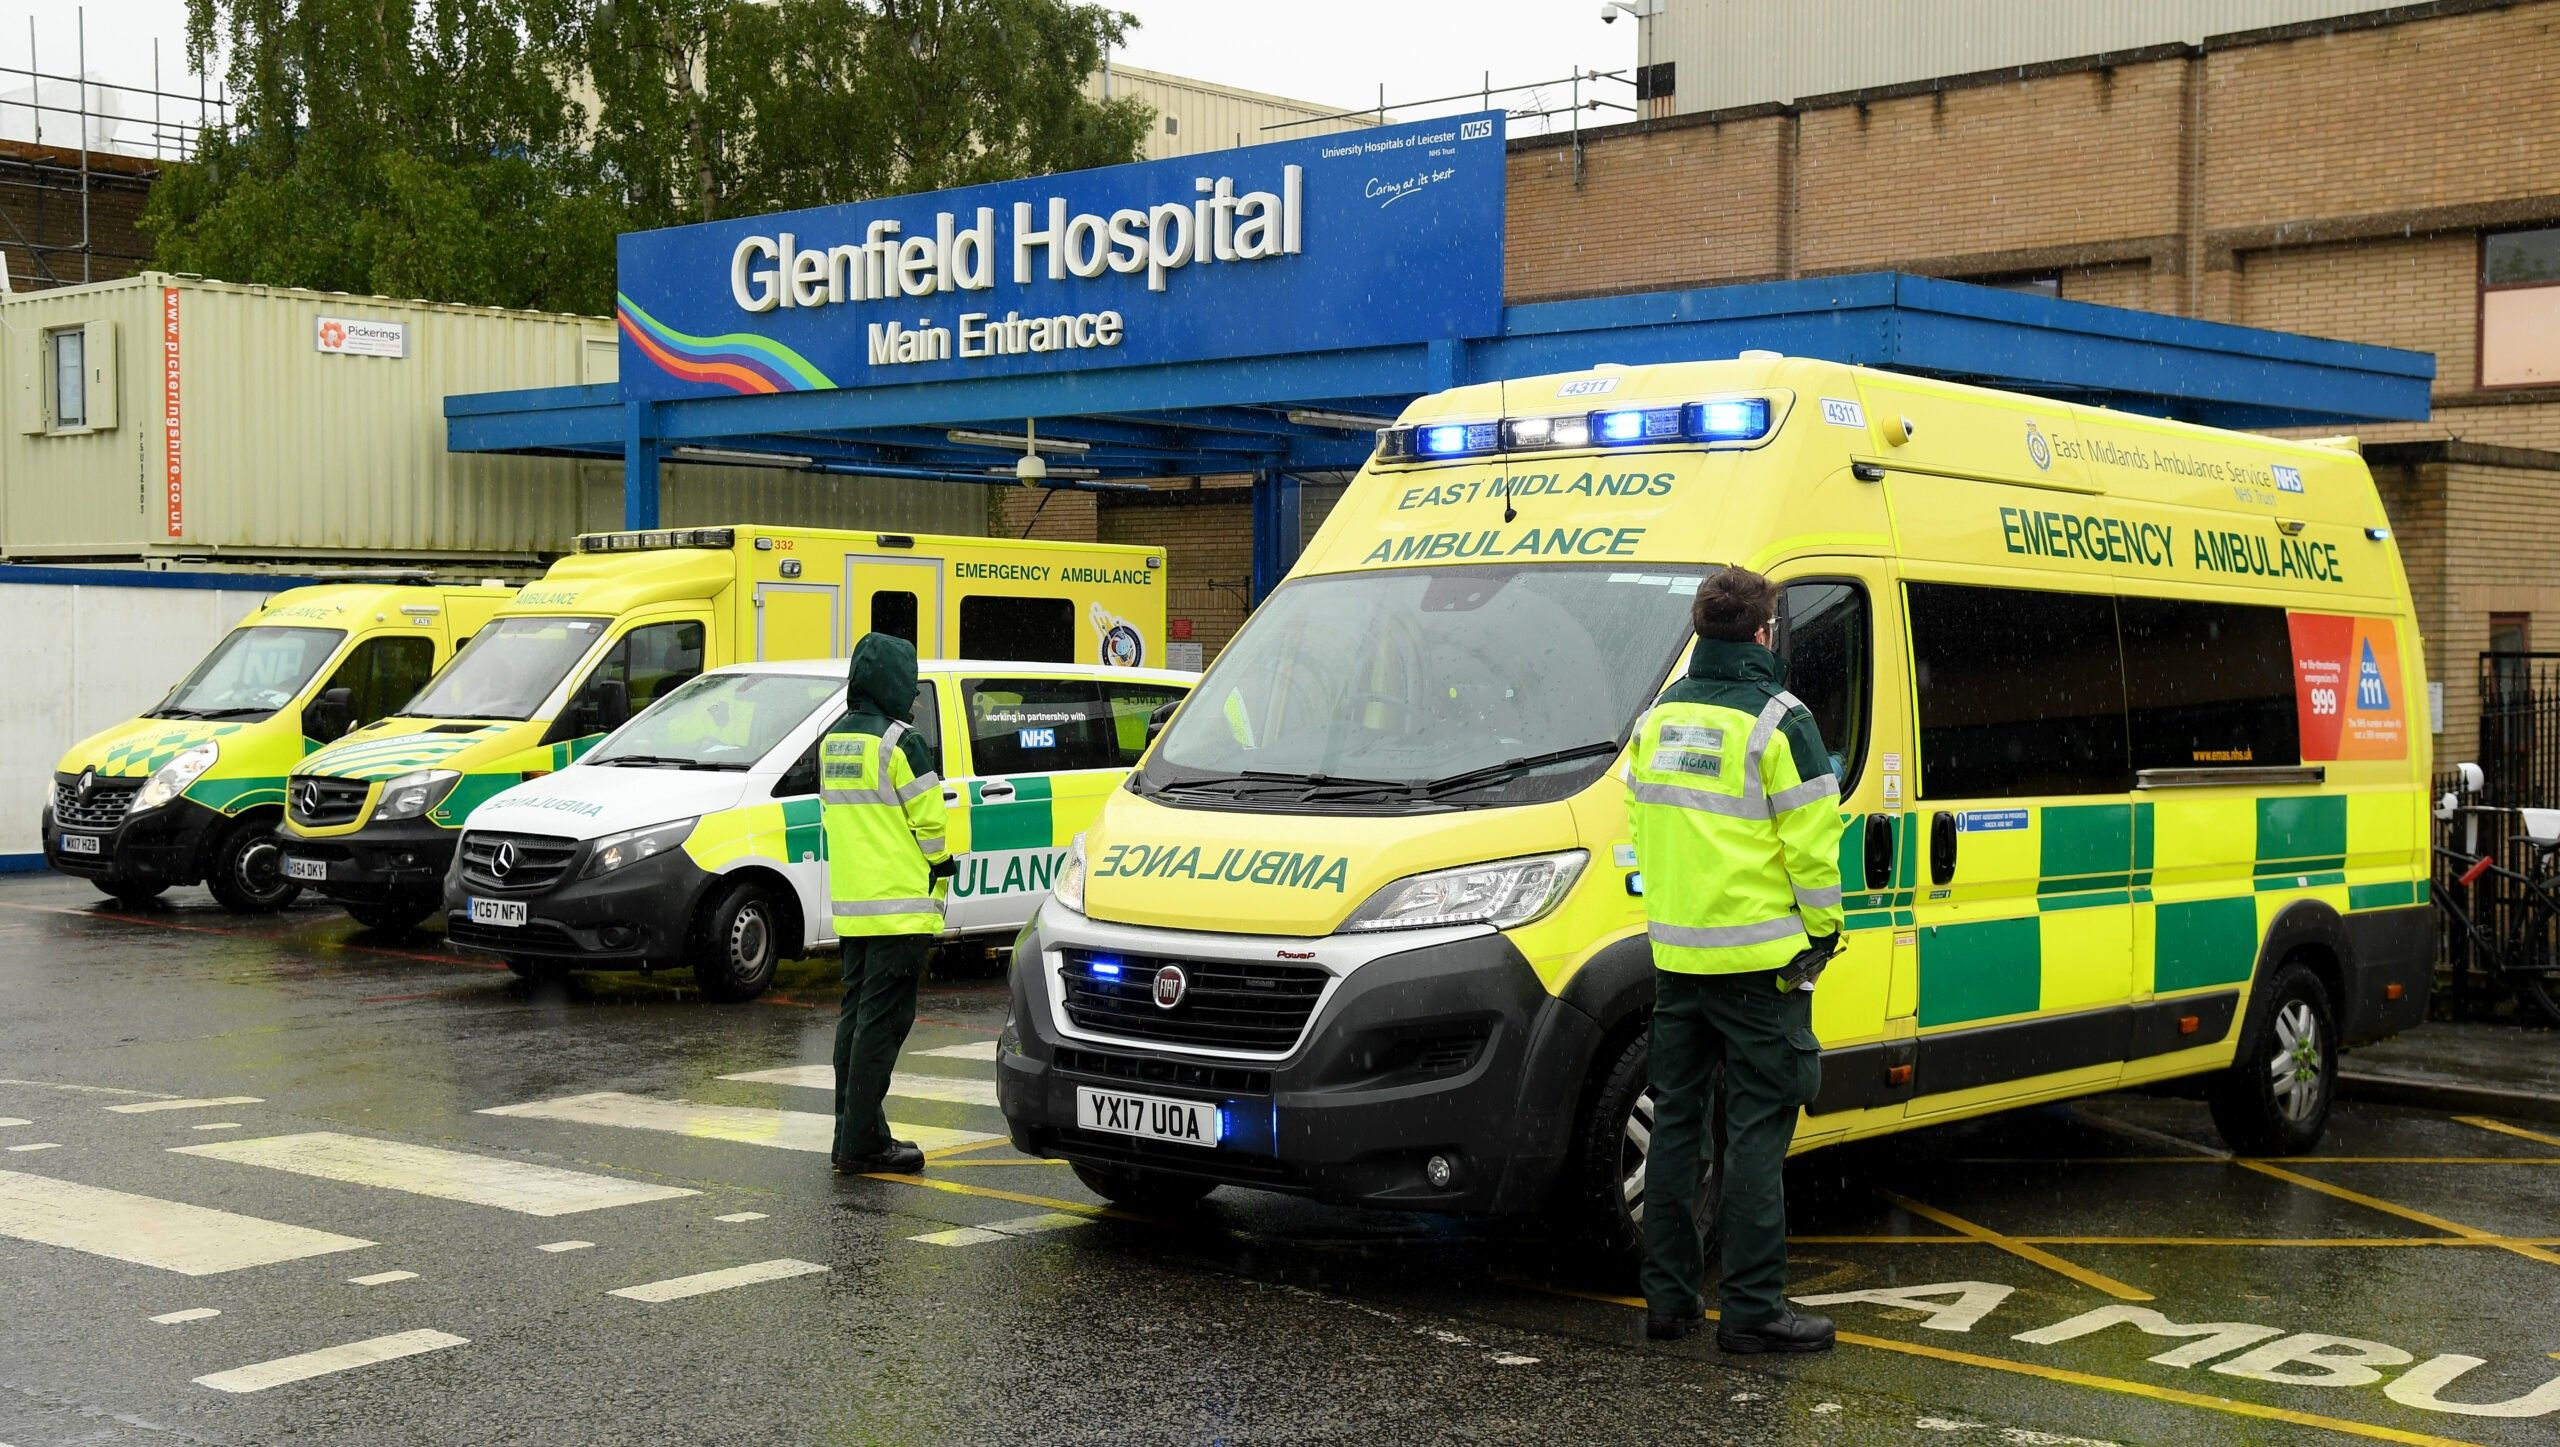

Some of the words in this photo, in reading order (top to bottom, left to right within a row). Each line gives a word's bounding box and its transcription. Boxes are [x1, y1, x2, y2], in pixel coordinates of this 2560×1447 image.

[1462, 121, 1490, 139] NHS
[1322, 144, 1363, 159] University
[1365, 138, 1404, 153] Hospitals
[1406, 135, 1416, 147] of
[1418, 131, 1456, 146] Leicester
[1442, 148, 1456, 156] Trust
[1365, 178, 1401, 198] Caring
[1403, 177, 1414, 190] at
[1417, 173, 1428, 186] its
[1432, 168, 1456, 183] best
[730, 206, 995, 312] Glenfield
[1014, 165, 1303, 292] Hospital
[348, 325, 401, 341] Pickerings
[868, 318, 952, 366] Main
[959, 310, 1123, 359] Entrance
[1565, 379, 1610, 395] 4311
[165, 294, 182, 531] www.pickeringshire.co.uk
[1828, 402, 1859, 424] 4311
[2051, 434, 2085, 461] East
[2087, 440, 2150, 470] Midlands
[2154, 450, 2225, 481] Ambulance
[2226, 461, 2272, 488] Service
[2273, 467, 2303, 492] NHS
[1398, 479, 1486, 511] EAST
[1487, 472, 1676, 499] MIDLANDS
[2234, 487, 2253, 503] NHS
[2254, 490, 2277, 507] Trust
[774, 540, 794, 551] 332
[1361, 527, 1647, 565] AMBULANCE
[2000, 507, 2173, 567] EMERGENCY
[2194, 529, 2343, 583] AMBULANCE
[955, 562, 1051, 582] EMERGENCY
[1060, 567, 1152, 586] AMBULANCE
[515, 592, 579, 606] AMBULANCE
[2361, 661, 2378, 674] CALL
[2311, 688, 2337, 715] 999
[2360, 678, 2383, 705] 111
[986, 712, 1017, 723] working
[1017, 711, 1026, 721] in
[1027, 711, 1069, 723] partnership
[1071, 711, 1086, 721] with
[1020, 729, 1054, 747] NHS
[2193, 750, 2253, 761] www.emas.nhs.uk
[473, 901, 499, 919] YC67
[501, 904, 525, 922] NFN
[1159, 979, 1180, 999] FIAT
[1092, 1094, 1145, 1131] YX17
[1152, 1102, 1201, 1140] UOA
[1788, 1279, 2560, 1417] AMBU
